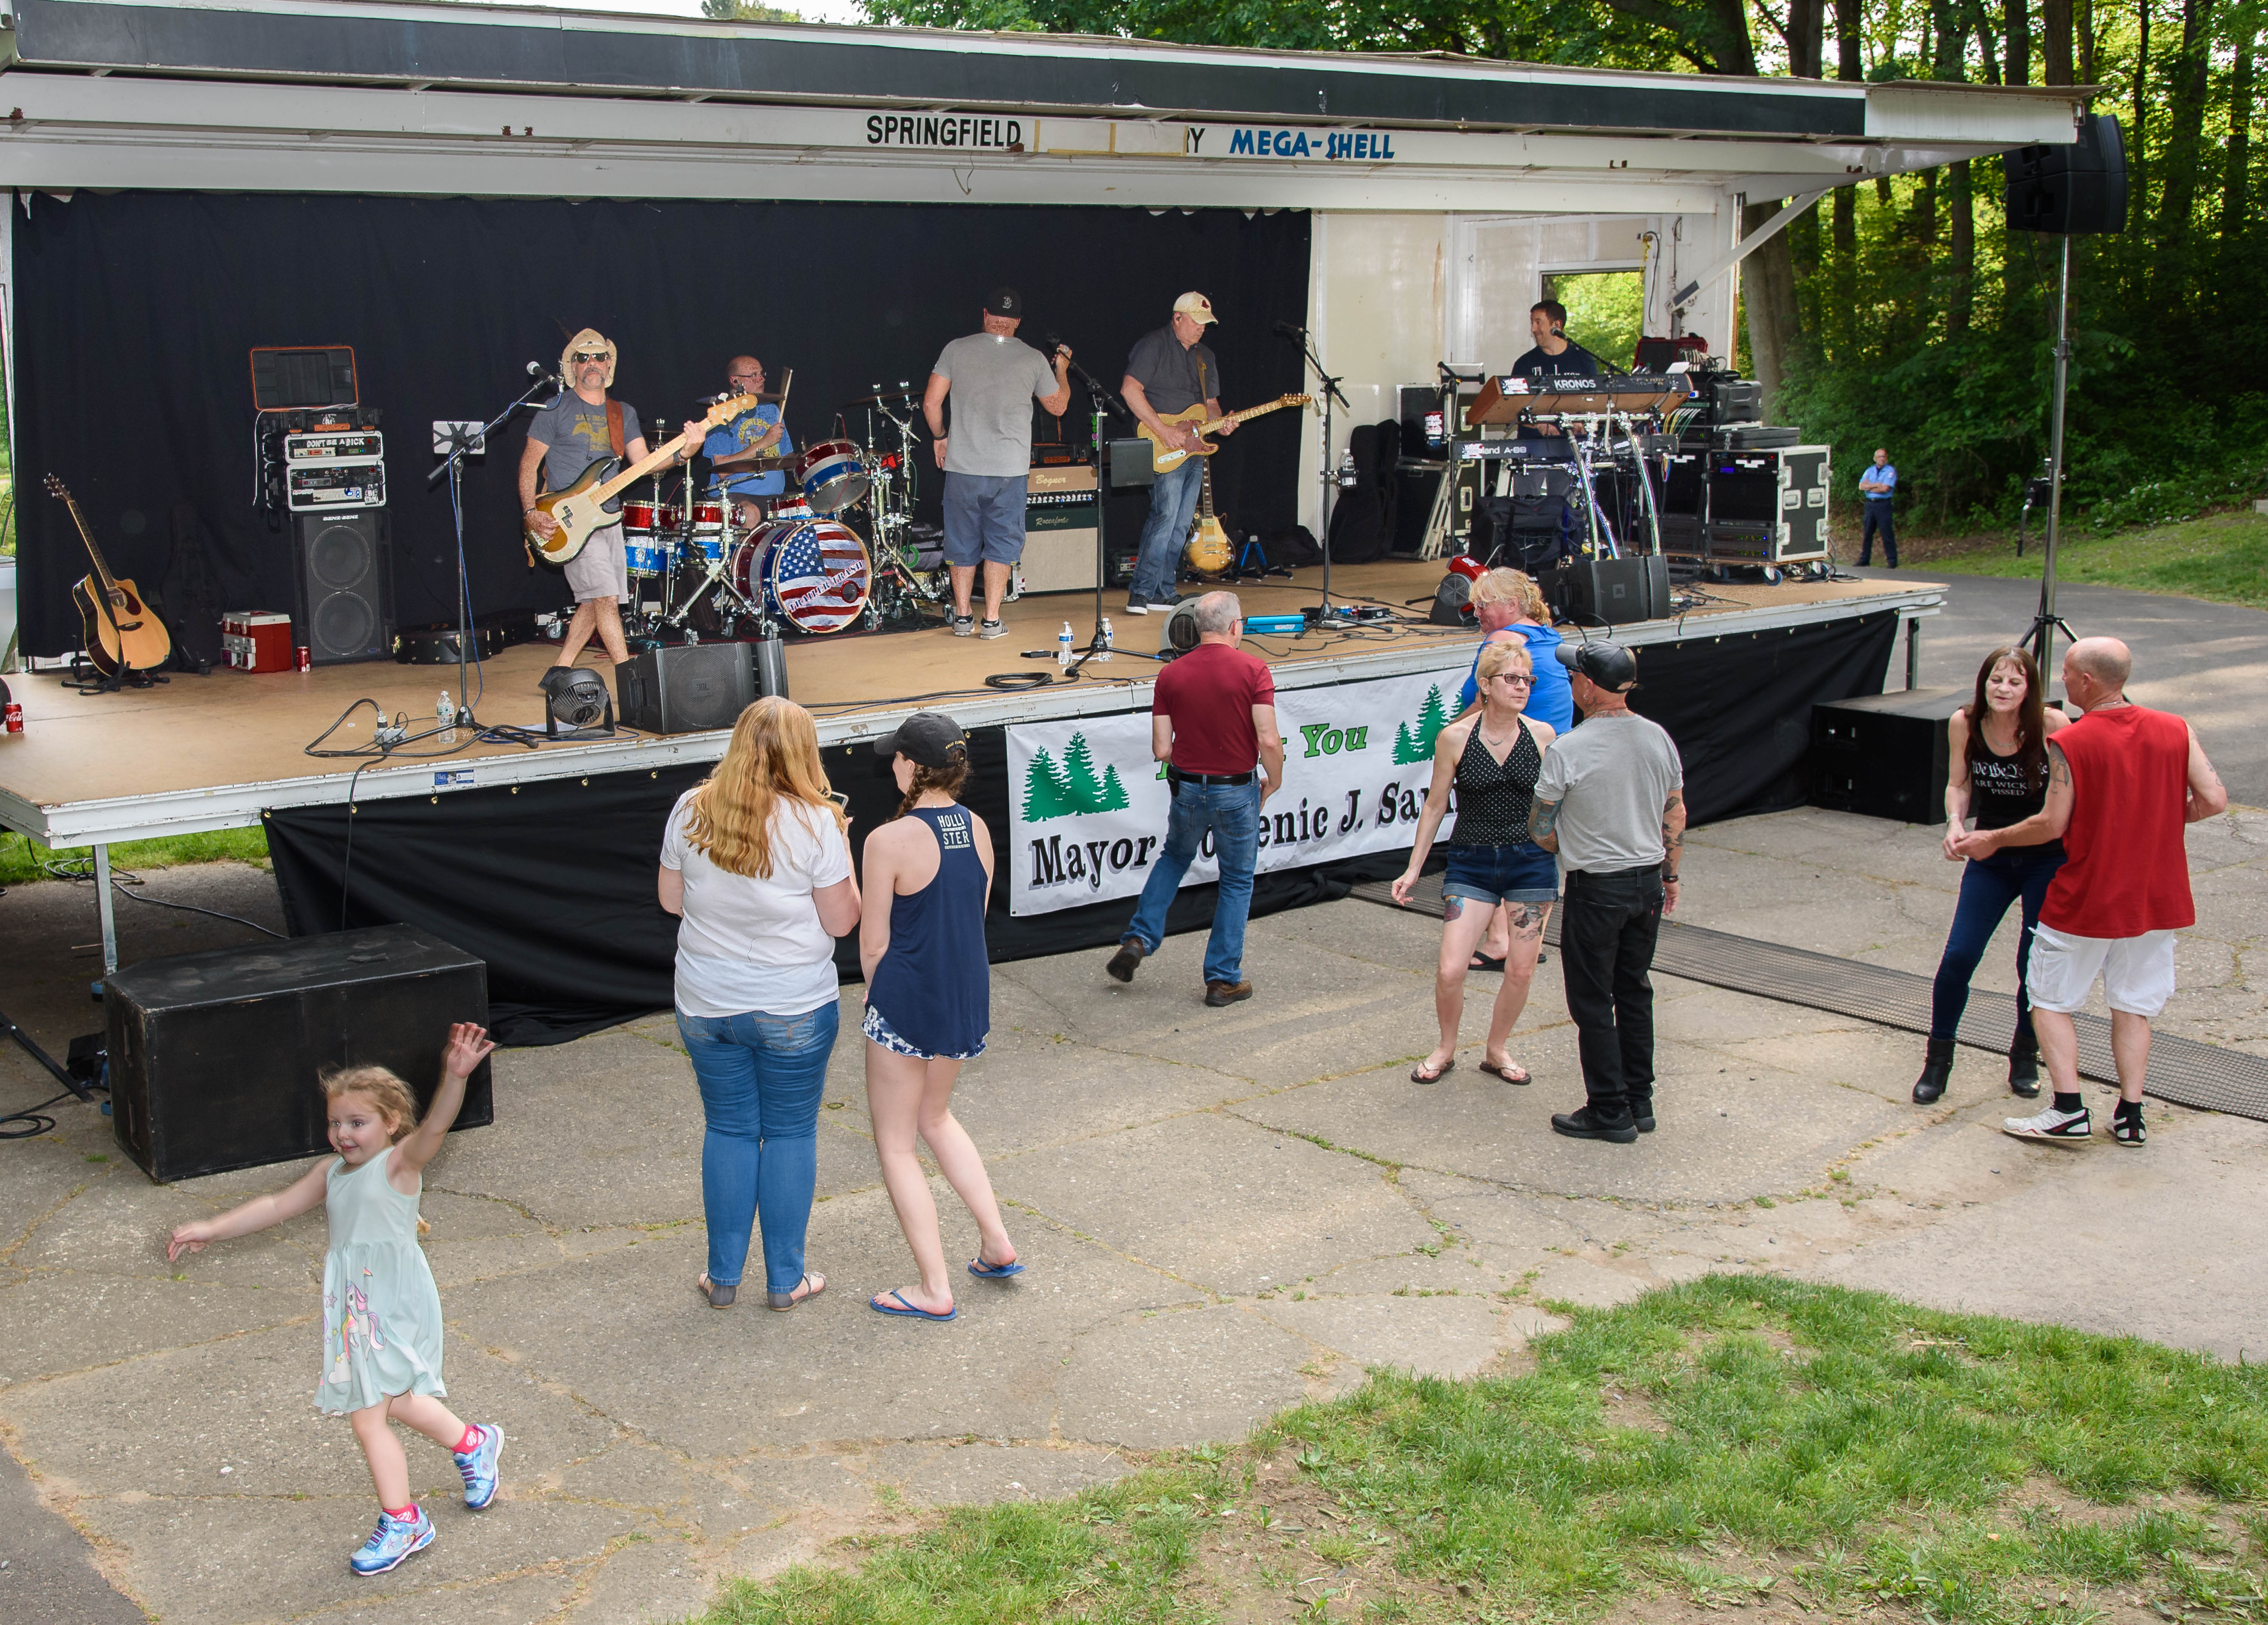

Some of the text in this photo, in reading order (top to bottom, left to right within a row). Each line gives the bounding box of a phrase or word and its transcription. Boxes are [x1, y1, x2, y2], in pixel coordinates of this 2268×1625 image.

[867, 115, 1021, 147] SPRINGFIELD
[1229, 129, 1395, 159] MEGA-SHELL
[1554, 379, 1596, 389] KRONOS
[1483, 446, 1500, 454] land
[1036, 475, 1067, 487] Bogner
[789, 560, 863, 612] TRAILER TRASH
[1300, 723, 1368, 758] You
[937, 813, 965, 827] HOLLI
[943, 831, 970, 845] STER
[1032, 834, 1156, 888] Mayor
[1340, 789, 1363, 832] J.
